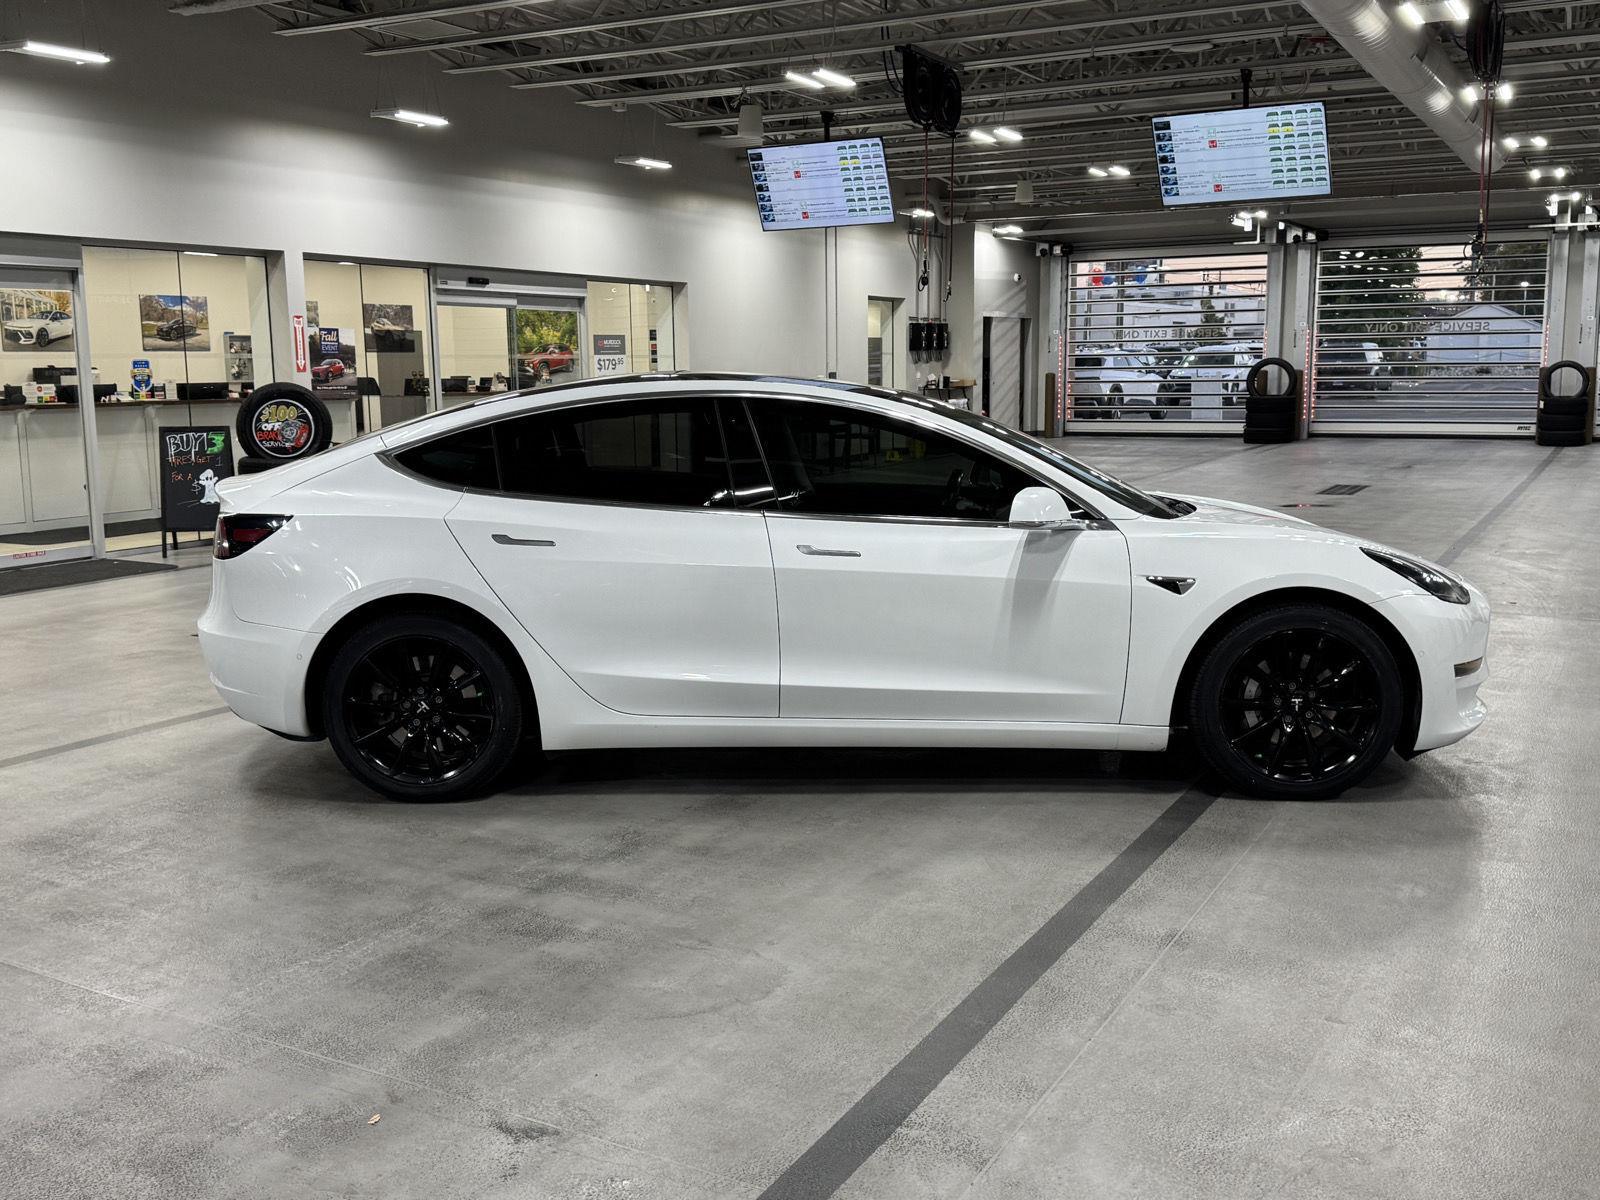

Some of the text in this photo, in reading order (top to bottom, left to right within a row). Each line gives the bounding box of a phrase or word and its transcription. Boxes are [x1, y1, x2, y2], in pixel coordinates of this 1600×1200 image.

[320, 330, 338, 341] Fall
[260, 405, 298, 422] $100
[261, 422, 282, 431] OFF
[206, 431, 225, 454] 3
